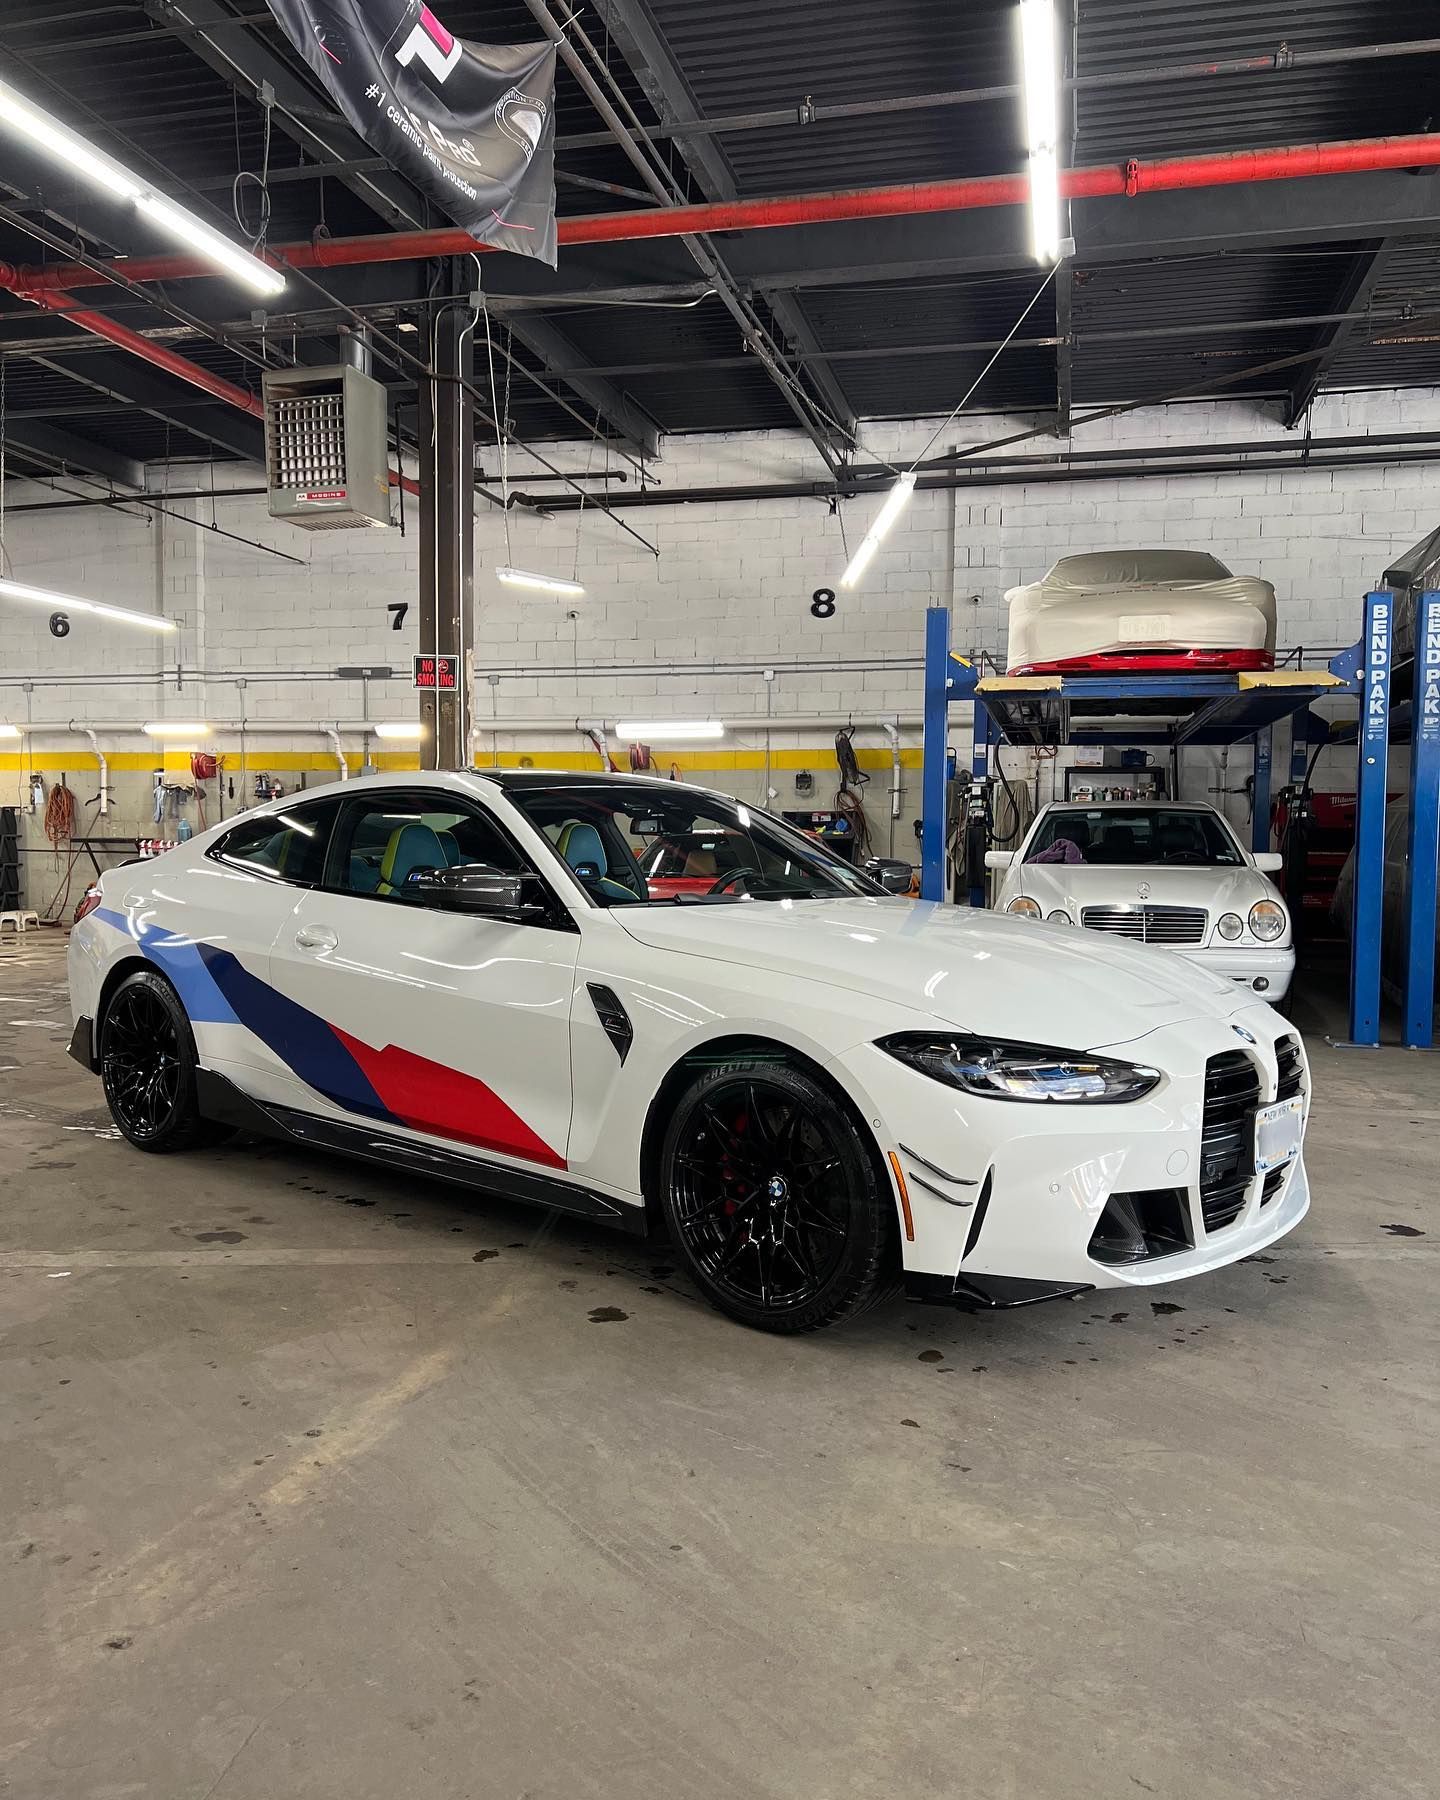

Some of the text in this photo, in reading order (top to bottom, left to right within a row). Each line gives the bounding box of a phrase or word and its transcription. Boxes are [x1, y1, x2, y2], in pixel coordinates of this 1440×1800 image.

[364, 83, 387, 107] #1
[387, 105, 423, 148] ceramic
[423, 143, 444, 171] paint
[443, 166, 478, 201] protection
[387, 602, 409, 631] 7
[811, 588, 836, 618] 8
[49, 611, 70, 637] 6
[417, 672, 455, 687] SMOING
[421, 660, 434, 673] NO
